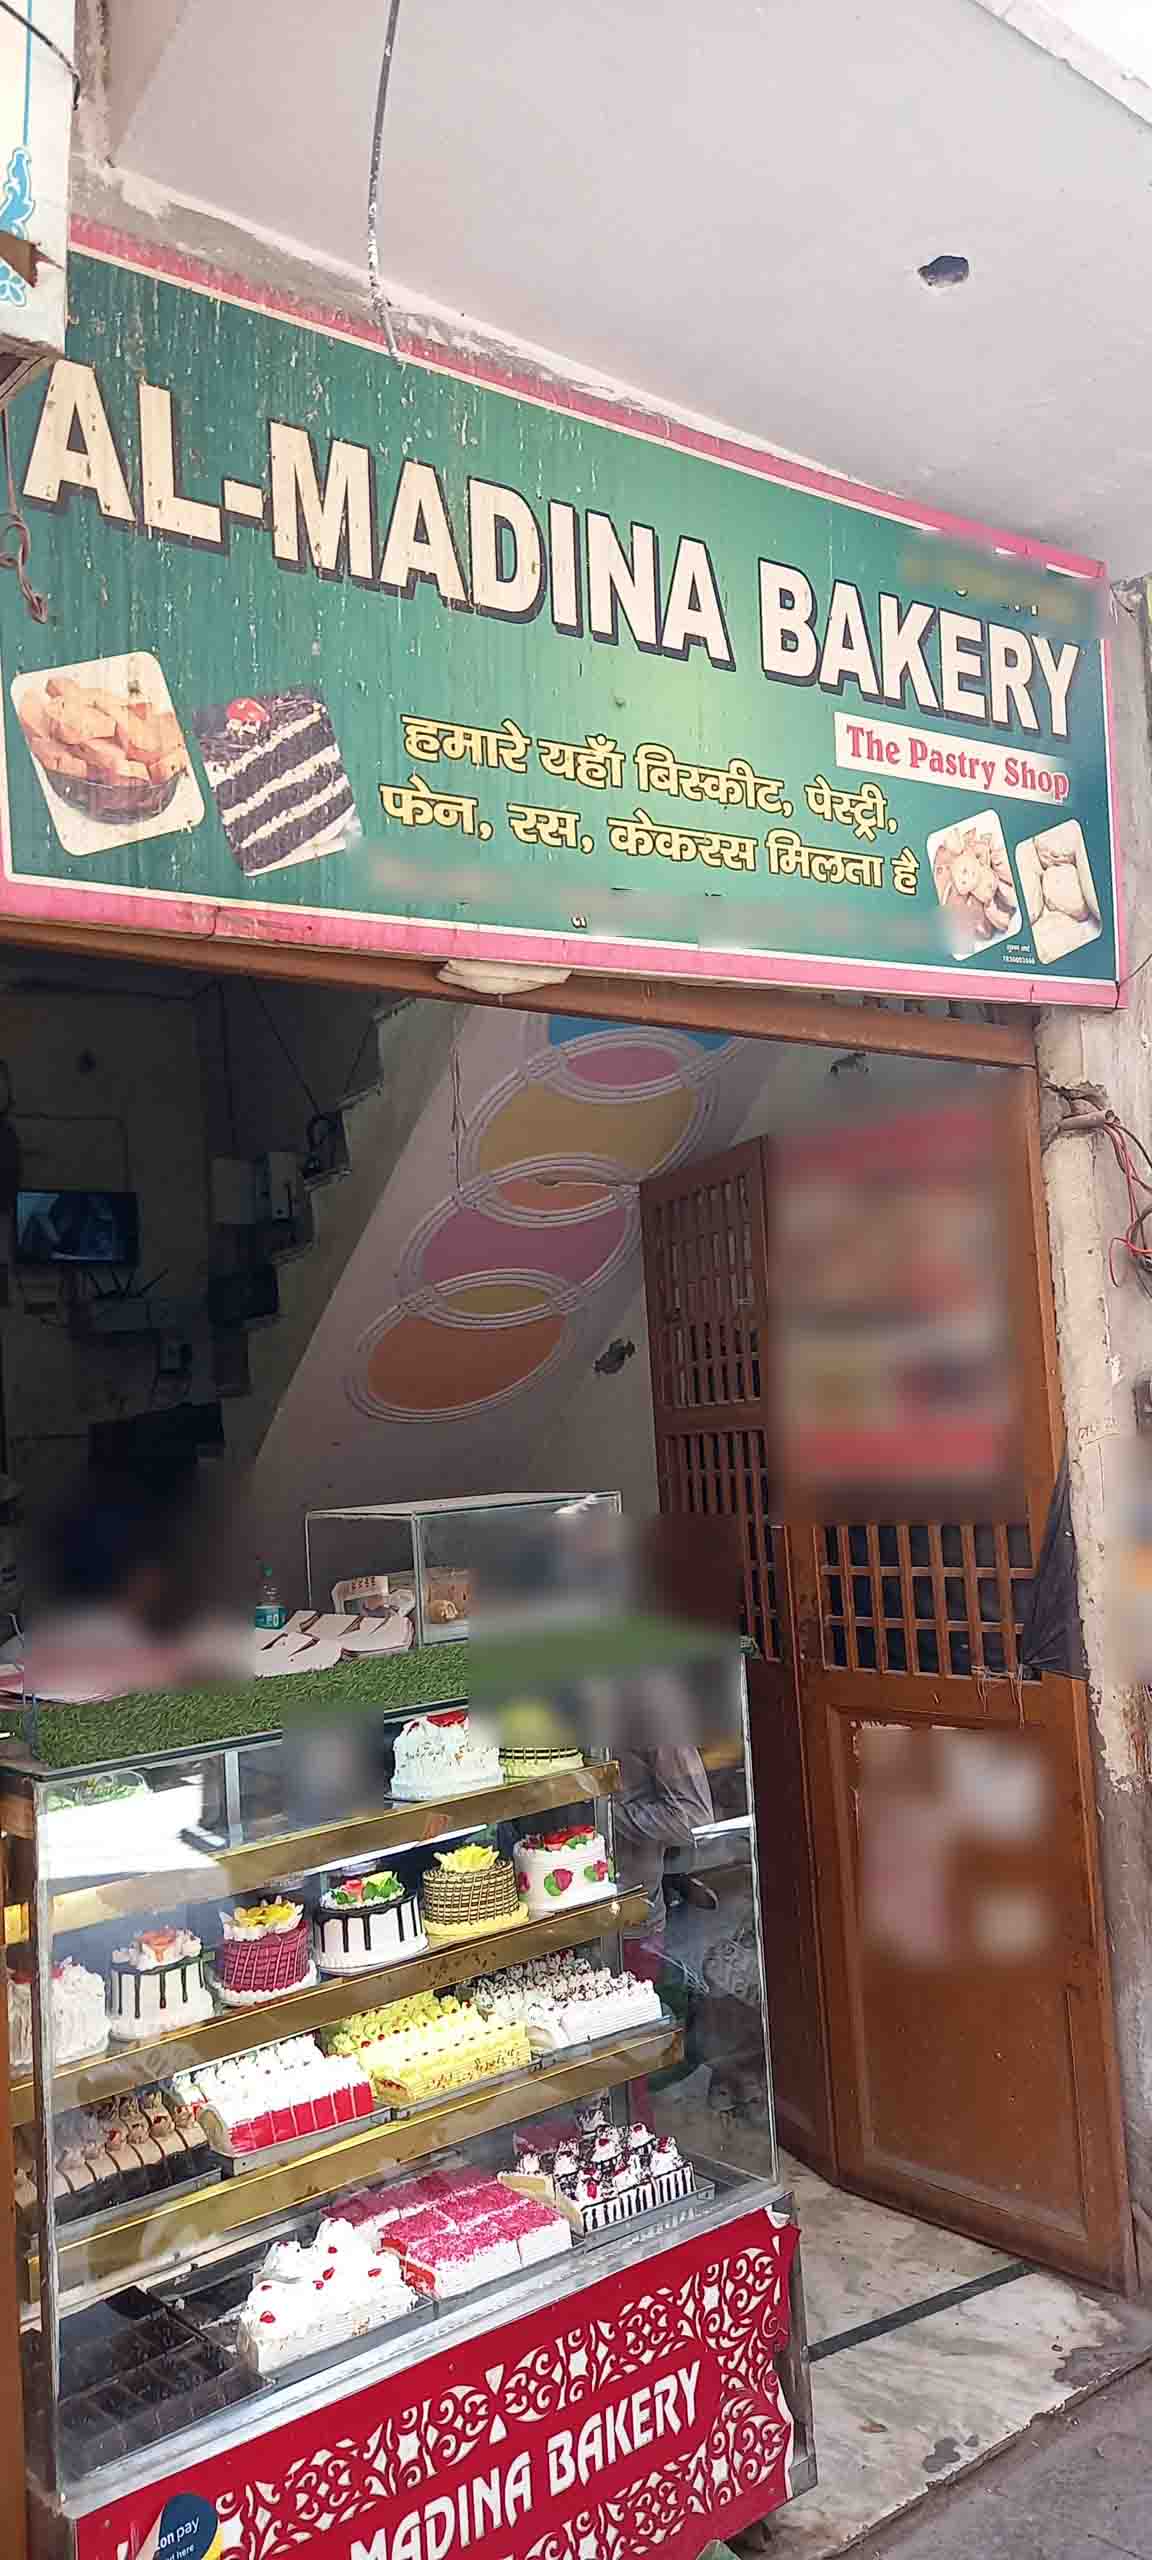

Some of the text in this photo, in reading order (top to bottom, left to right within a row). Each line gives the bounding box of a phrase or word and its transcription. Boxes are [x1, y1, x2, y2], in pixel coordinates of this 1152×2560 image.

[22, 358, 1080, 740] AL-MADINA BAKERY
[400, 714, 898, 842] हमारे यहाँ बिस्कीट, पेस्ट्री,
[846, 724, 1071, 801] The Pastry Shop
[378, 773, 920, 896] फेन, रस, केकरस मिलता है
[547, 2360, 701, 2498] BAKERY
[176, 2516, 199, 2542] pay
[176, 2543, 195, 2559] here
